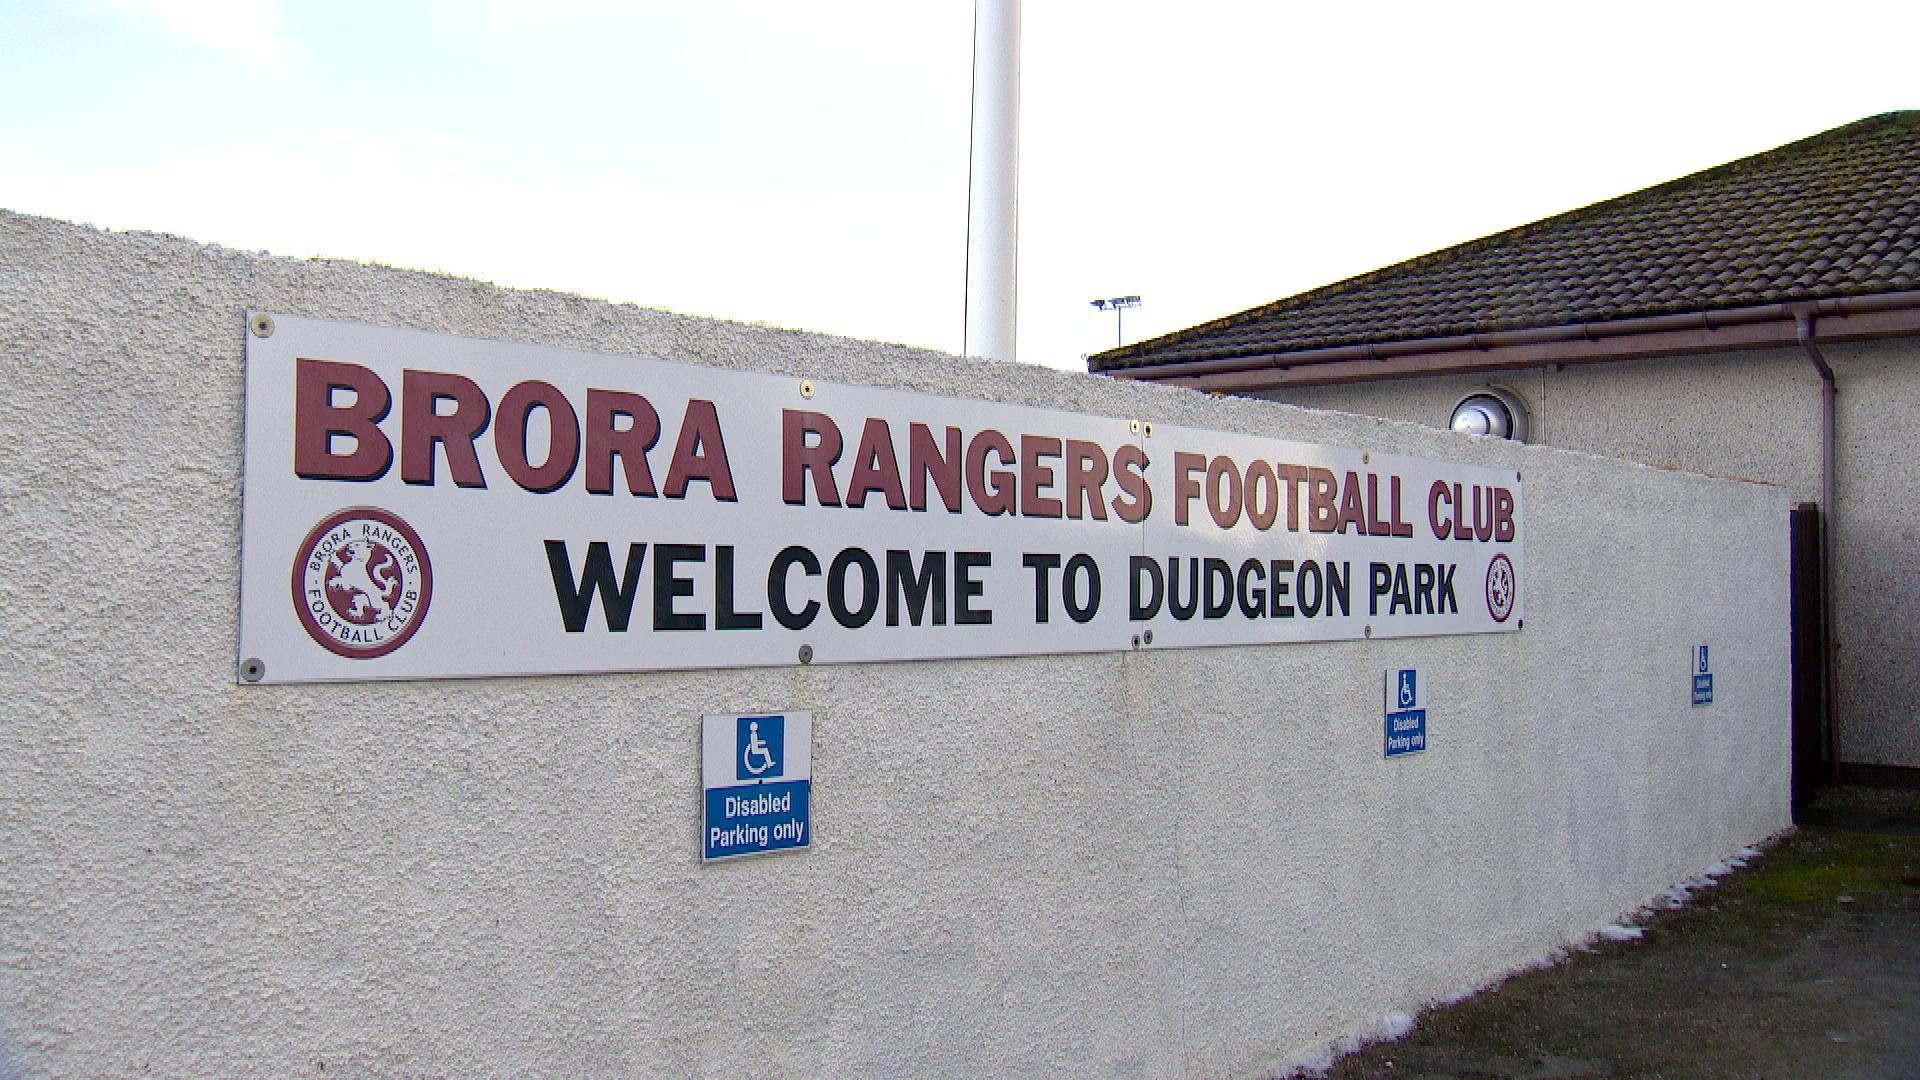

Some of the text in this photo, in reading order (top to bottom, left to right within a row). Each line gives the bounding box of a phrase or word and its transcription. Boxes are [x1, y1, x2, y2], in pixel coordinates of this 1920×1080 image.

[295, 357, 1515, 542] BRORA RANGERS FOOTBALL CLUB
[310, 523, 418, 574] BRORA RANGERS
[544, 540, 993, 632] WELCOME
[1022, 553, 1102, 624] TO
[1129, 555, 1350, 621] DUDGEON
[1369, 561, 1458, 616] PARK
[308, 589, 418, 643] FOOTBALL CLUB
[1388, 732, 1424, 751] Parking only
[1394, 716, 1419, 731] Disabled
[725, 791, 791, 819] Disabled
[710, 817, 805, 849] Parking only
